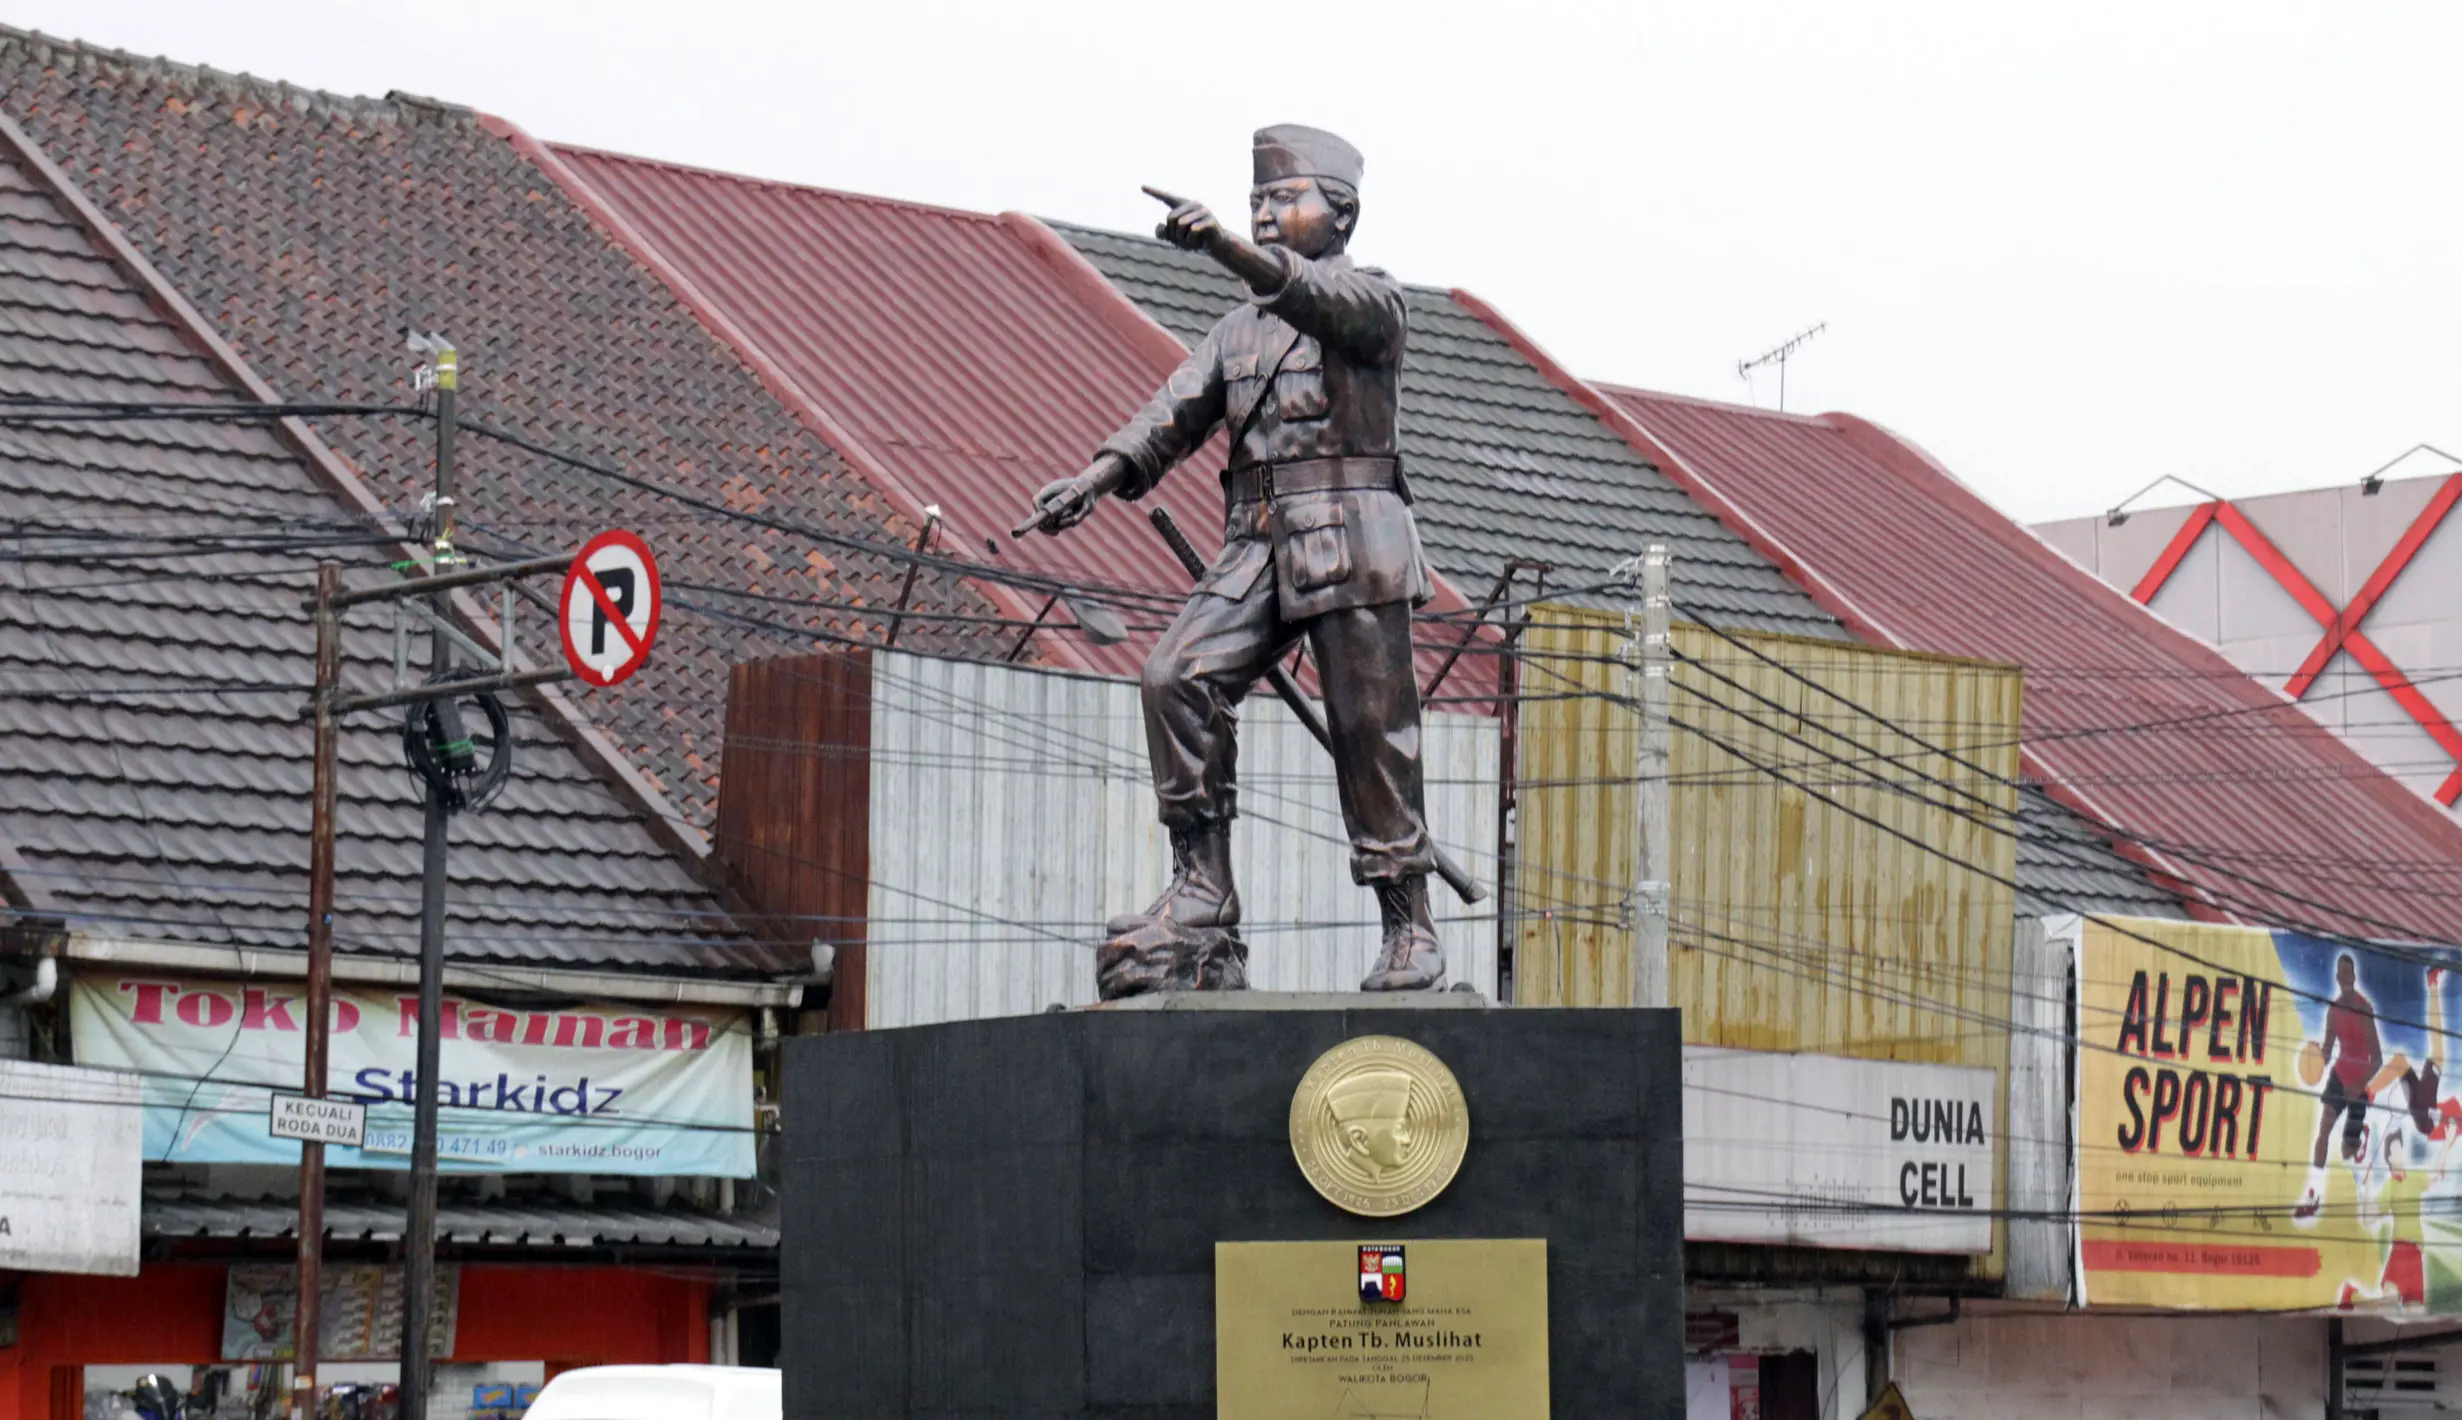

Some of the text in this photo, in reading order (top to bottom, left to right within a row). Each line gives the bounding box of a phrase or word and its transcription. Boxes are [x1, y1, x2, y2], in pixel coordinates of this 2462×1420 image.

[591, 567, 635, 656] P
[119, 981, 712, 1051] Toko Mainan
[2117, 970, 2272, 1065] ALPEN
[285, 1101, 352, 1122] KECUALI
[355, 1067, 623, 1115] Starkidz
[2117, 1066, 2274, 1162] SPORT
[277, 1117, 357, 1141] RODA DUA
[1890, 1096, 1985, 1146] DUNIA
[538, 1143, 662, 1161] starkidz.bogor
[1900, 1160, 1973, 1208] CELL
[1282, 1331, 1483, 1352] Kapten Tb. Muslihat
[1329, 1318, 1436, 1329] PATUNG PAHLAWAN
[1338, 1373, 1428, 1384] WALIKOTA BOGOR
